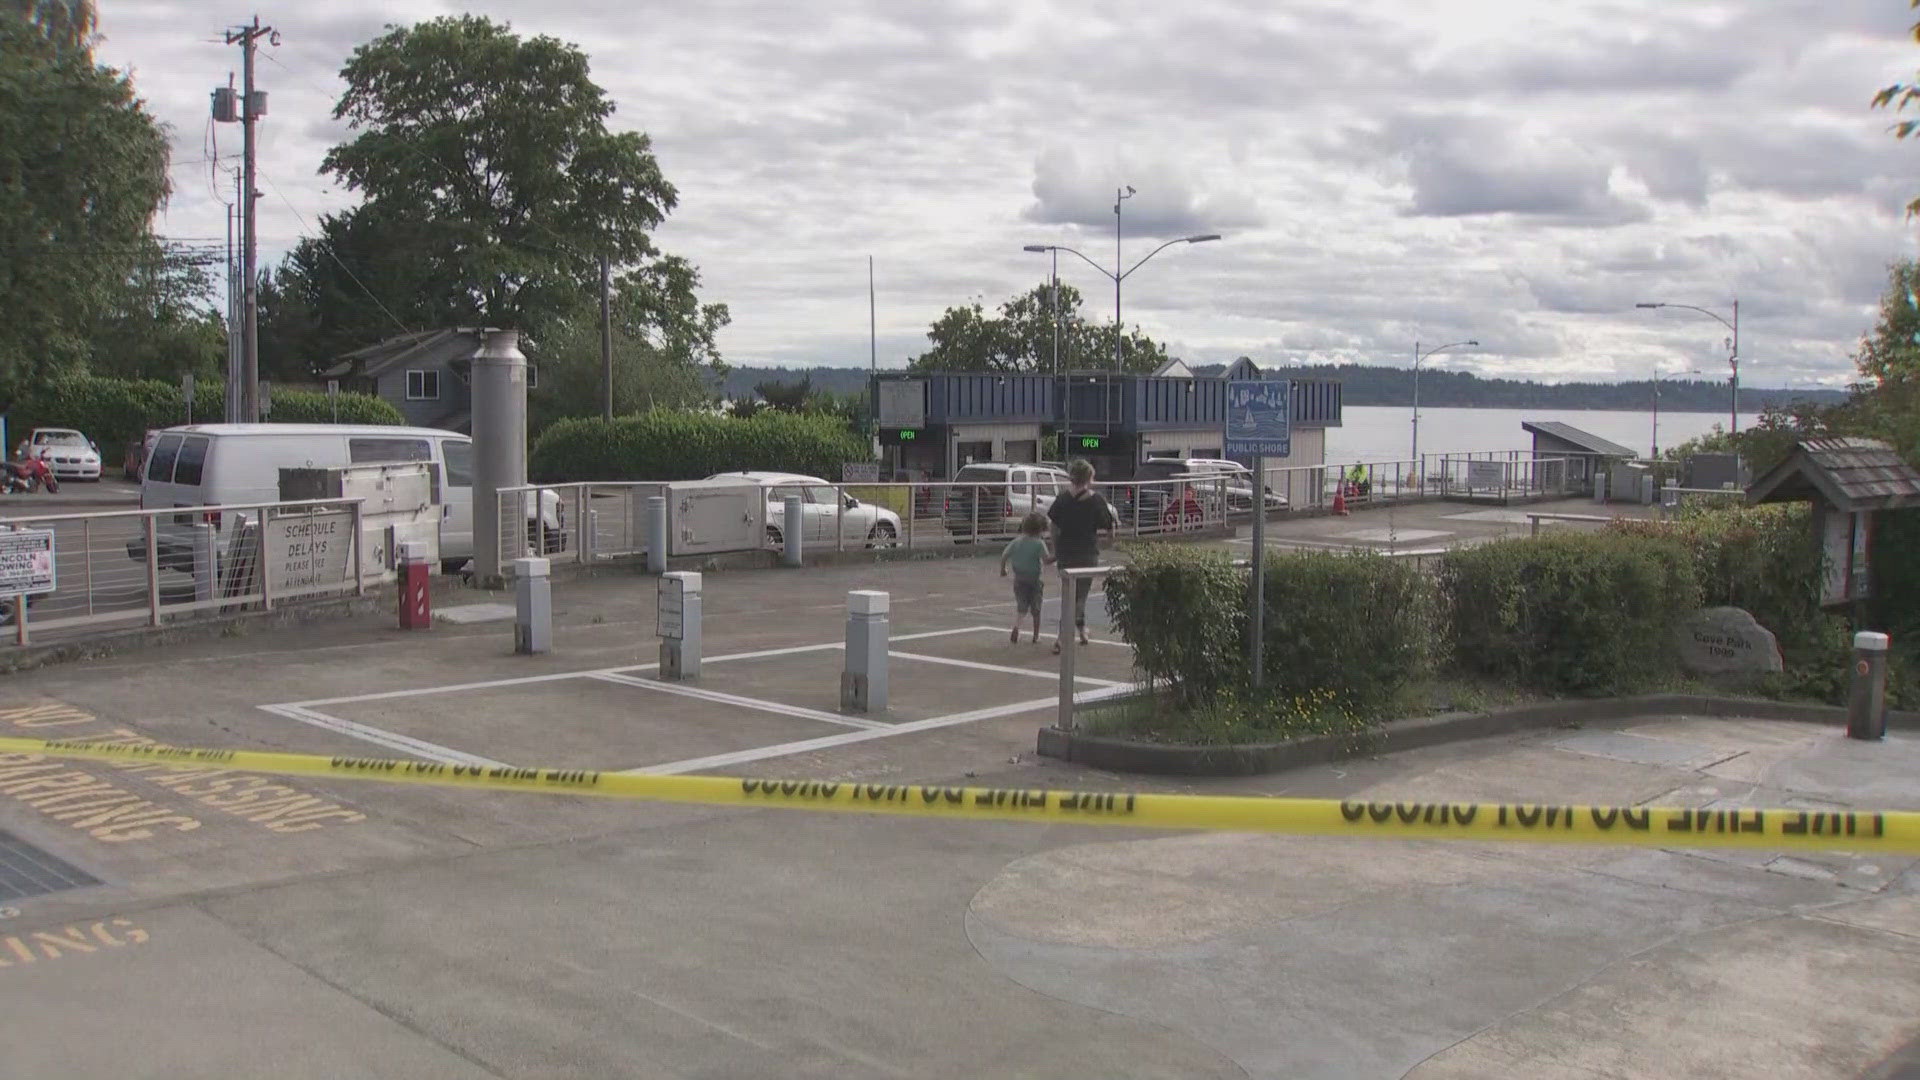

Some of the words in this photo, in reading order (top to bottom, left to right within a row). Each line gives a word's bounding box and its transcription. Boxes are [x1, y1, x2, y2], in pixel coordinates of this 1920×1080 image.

[900, 431, 916, 440] OPEN
[1082, 439, 1099, 448] OPEN
[1227, 443, 1258, 453] PUBLIC
[1259, 443, 1288, 454] SHORE
[285, 521, 336, 538] SCHEDULE
[1165, 513, 1202, 532] STOP
[288, 540, 328, 557] DELAYS
[285, 559, 310, 572] PLEASE
[1694, 631, 1723, 644] Cove
[1726, 636, 1752, 650] Park
